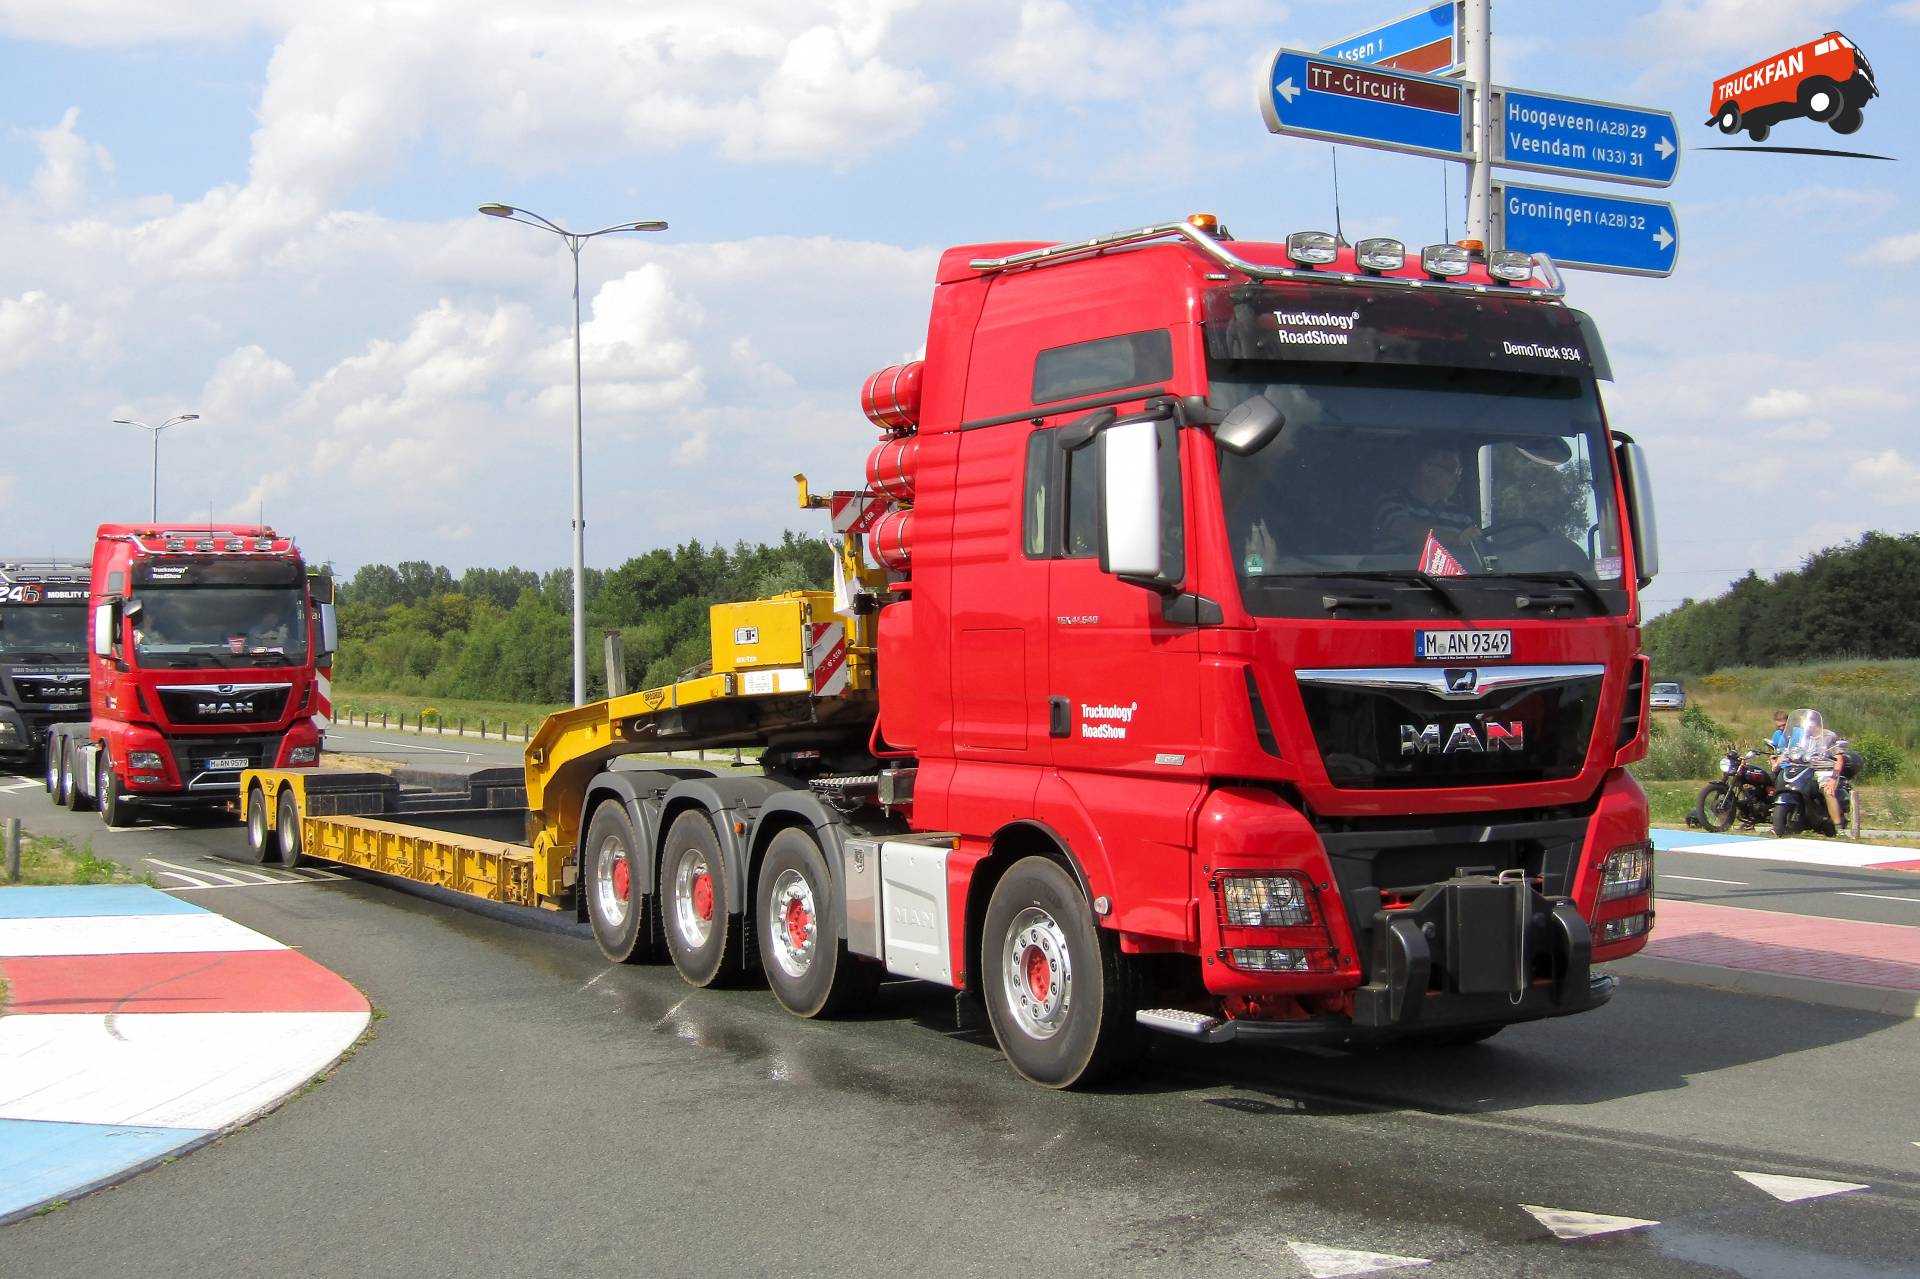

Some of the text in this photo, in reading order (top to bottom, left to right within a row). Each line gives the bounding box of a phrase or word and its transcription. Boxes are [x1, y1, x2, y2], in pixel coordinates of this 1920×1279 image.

[1337, 38, 1384, 61] Assen 1
[1311, 67, 1406, 101] TT-Circuit
[1509, 103, 1647, 139] Hoogeveen (A28) 29
[1510, 132, 1643, 166] Veendam (N33) 31
[1509, 197, 1646, 230] Groningen (A28) 32
[1278, 329, 1348, 345] RoadShow
[1503, 341, 1581, 361] DemoTruck 934
[47, 591, 82, 599] MOBILITY
[1426, 633, 1509, 653] M AN 9349
[41, 687, 83, 696] MAN
[198, 702, 254, 714] MAN
[1081, 723, 1126, 739] RoadShow
[1400, 721, 1524, 754] MAN
[895, 906, 935, 929] MAN
